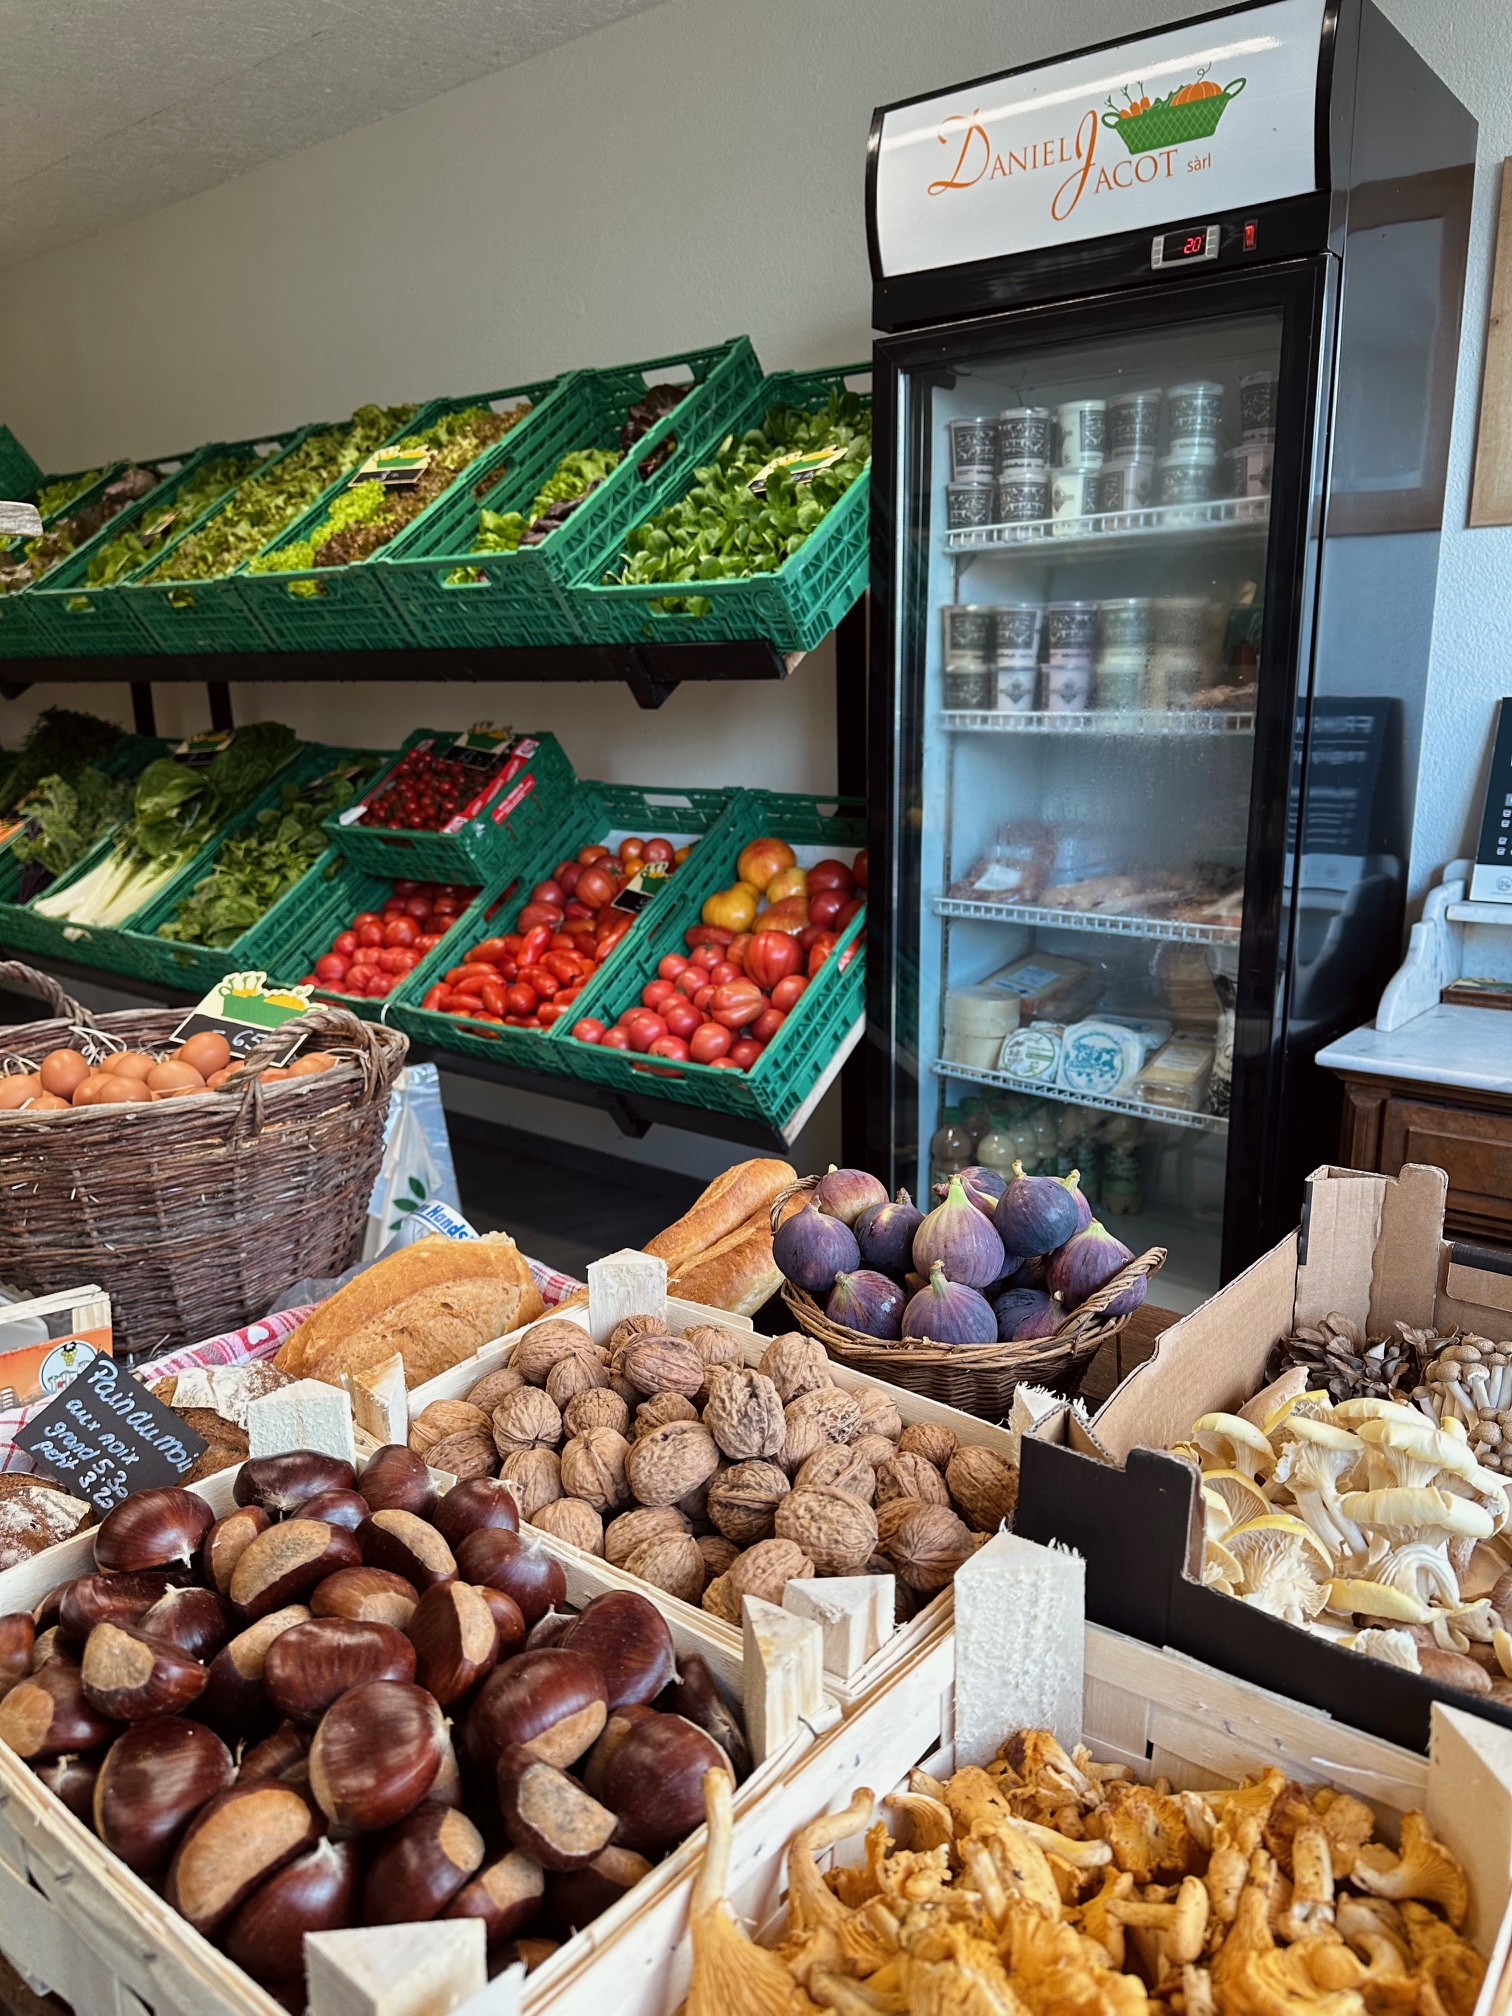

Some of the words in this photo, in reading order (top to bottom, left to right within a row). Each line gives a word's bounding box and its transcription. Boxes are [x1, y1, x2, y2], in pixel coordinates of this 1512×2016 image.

[927, 107, 1073, 196] DANIEL
[1051, 109, 1180, 222] JACOT
[1187, 153, 1212, 175] sàrl
[426, 1204, 468, 1239] Hands
[66, 1399, 101, 1432] aux
[98, 1432, 140, 1466] noix
[87, 1359, 136, 1416] Pain
[125, 1409, 157, 1443] du
[30, 1440, 80, 1471] petit
[79, 1470, 115, 1510] 3.20
[44, 1421, 102, 1461] grand
[92, 1457, 129, 1499] 5.30
